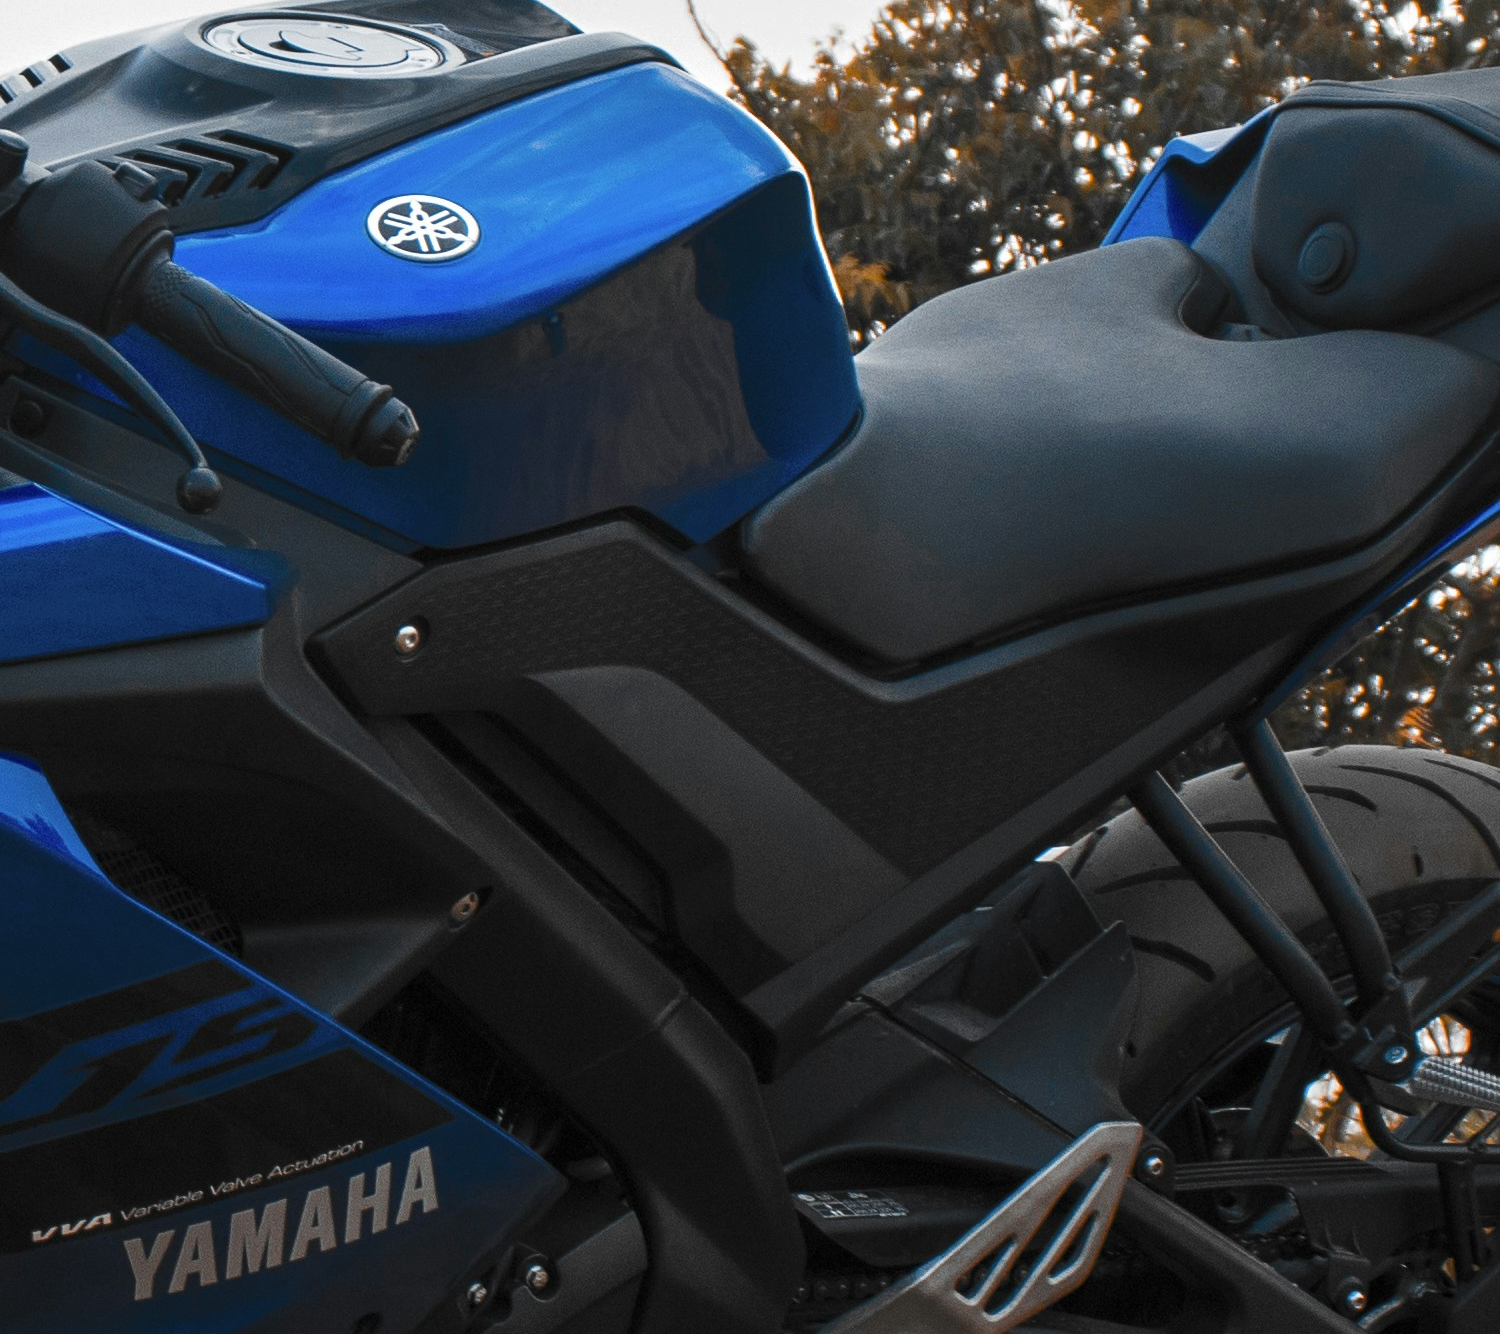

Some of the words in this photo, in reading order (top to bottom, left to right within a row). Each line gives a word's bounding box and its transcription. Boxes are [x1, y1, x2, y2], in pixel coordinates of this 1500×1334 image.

[30, 1212, 113, 1243] VVA
[120, 1189, 205, 1222] Variable
[210, 1170, 263, 1196] Valve
[266, 1139, 365, 1179] Actuation
[122, 1146, 440, 1302] YAMAHA
